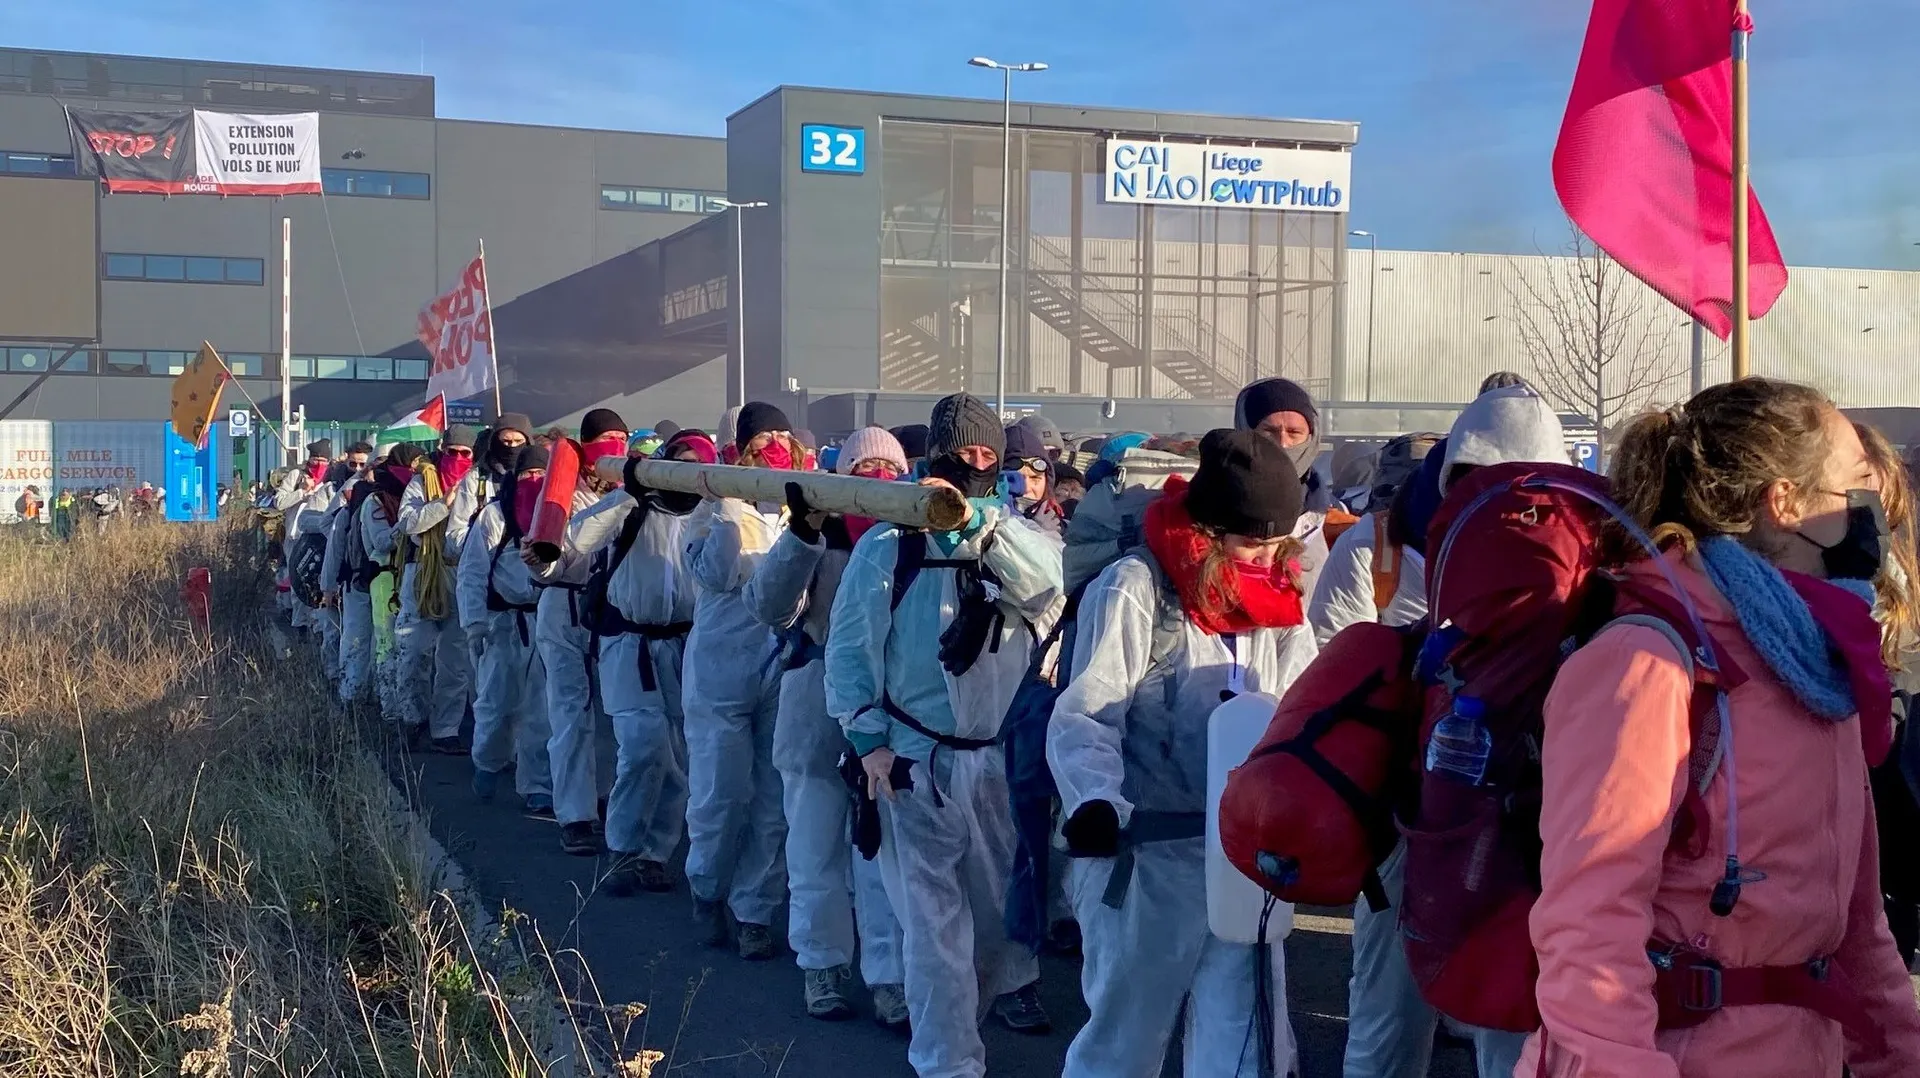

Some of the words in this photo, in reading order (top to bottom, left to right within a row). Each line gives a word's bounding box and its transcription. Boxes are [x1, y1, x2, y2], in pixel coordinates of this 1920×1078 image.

[228, 125, 294, 138] EXTENSION
[229, 142, 295, 155] POLLUTION
[810, 131, 857, 166] 32
[221, 159, 252, 172] VOLS
[257, 160, 272, 173] DE
[275, 160, 301, 173] NUIT
[184, 184, 217, 193] ROUGE
[67, 450, 112, 462] MILE
[1579, 445, 1592, 461] P
[60, 467, 136, 479] SERVICE
